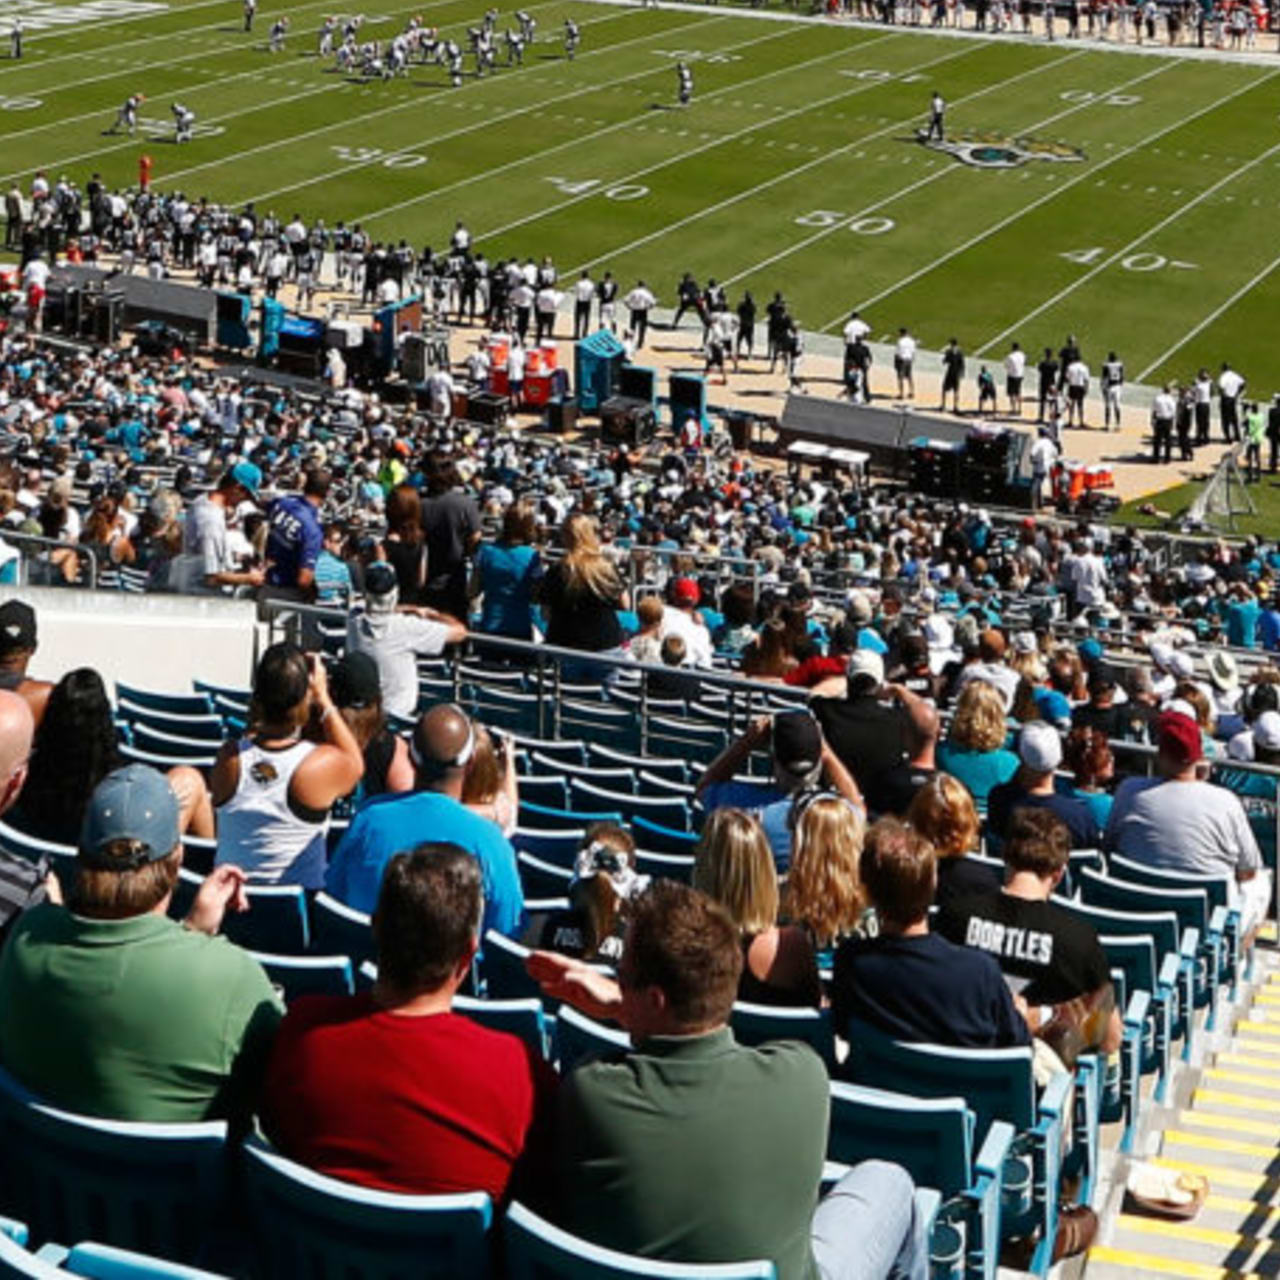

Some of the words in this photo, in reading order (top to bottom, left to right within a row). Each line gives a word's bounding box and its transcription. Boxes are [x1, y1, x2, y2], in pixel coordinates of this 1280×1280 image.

[794, 209, 896, 236] 50
[1058, 246, 1167, 272] 40
[966, 915, 1054, 965] BORTLES
